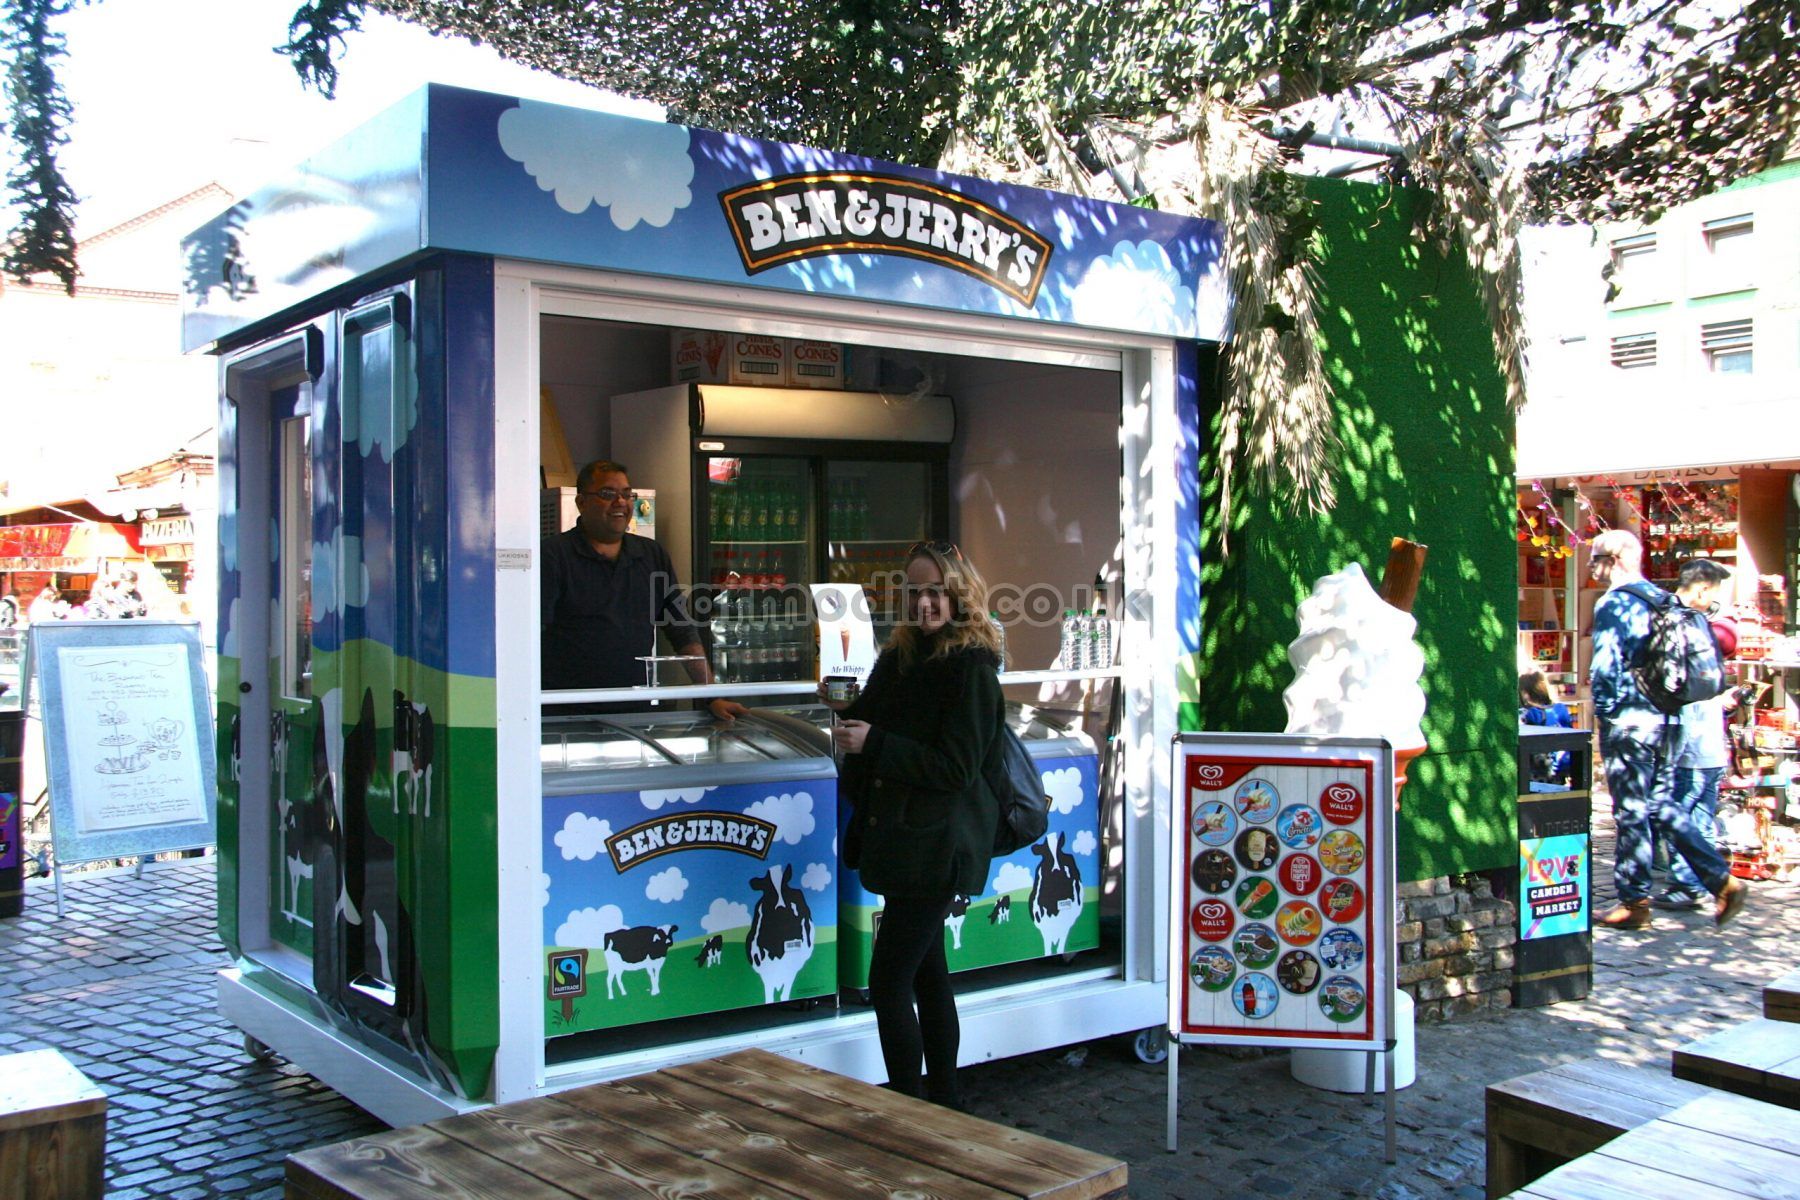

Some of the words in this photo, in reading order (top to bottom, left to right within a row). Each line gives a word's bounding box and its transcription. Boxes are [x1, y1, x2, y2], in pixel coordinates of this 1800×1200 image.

[736, 340, 783, 359] CONES
[794, 345, 839, 362] CONES
[1329, 803, 1354, 811] WALL'S
[1531, 884, 1573, 899] CAMDEN
[1536, 900, 1579, 916] MARKET
[1201, 919, 1226, 927] WALL'S
